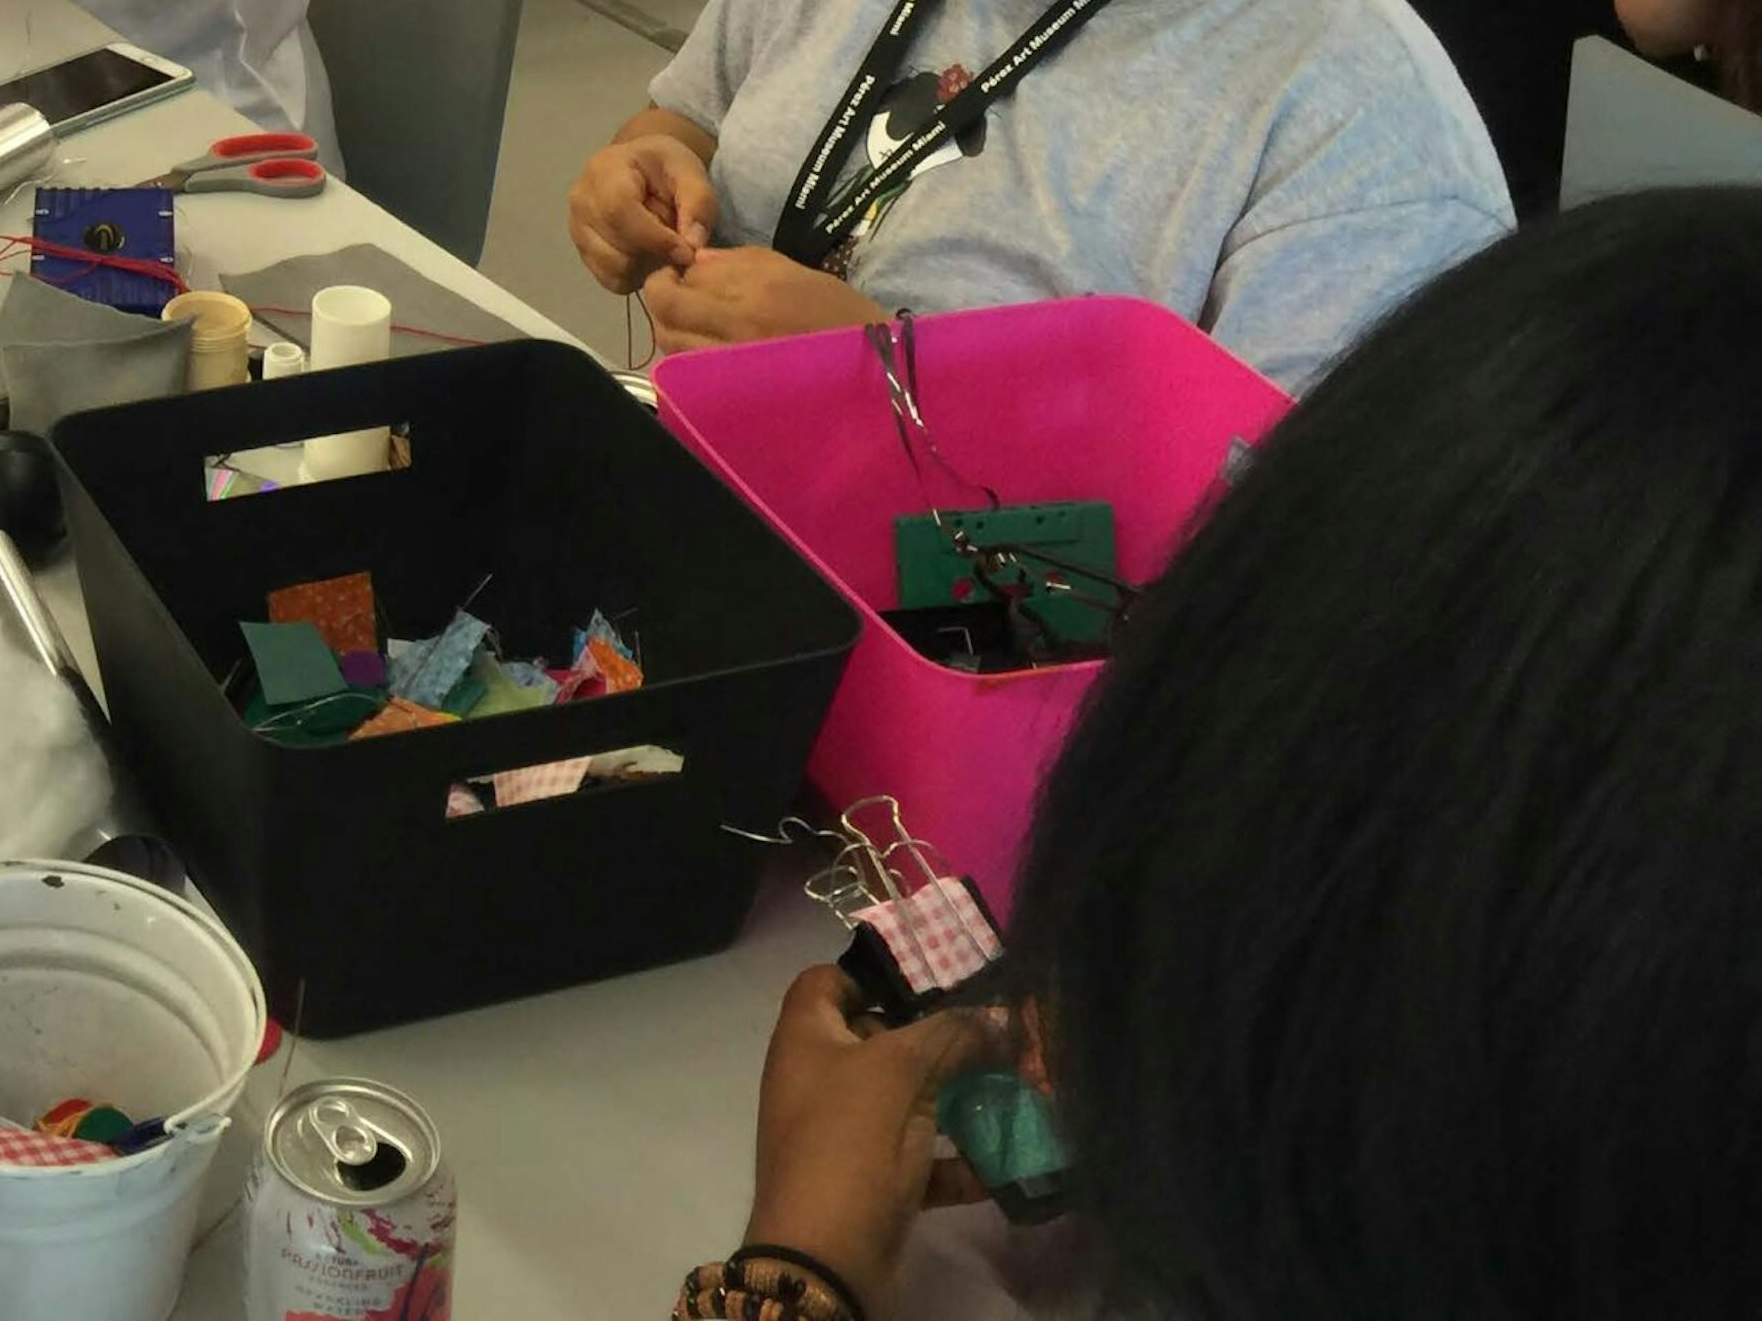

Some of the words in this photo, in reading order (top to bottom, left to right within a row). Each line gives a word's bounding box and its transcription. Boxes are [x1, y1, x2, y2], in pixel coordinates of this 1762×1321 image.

[890, 0, 914, 36] Miami
[981, 63, 1013, 93] Pérez
[1011, 46, 1034, 68] Art
[1027, 5, 1078, 51] Museum
[841, 101, 857, 128] Art
[811, 124, 846, 173] Museum
[851, 185, 873, 208] Art
[868, 147, 915, 190] Museum
[911, 120, 947, 153] Miami
[794, 170, 821, 210] Miami
